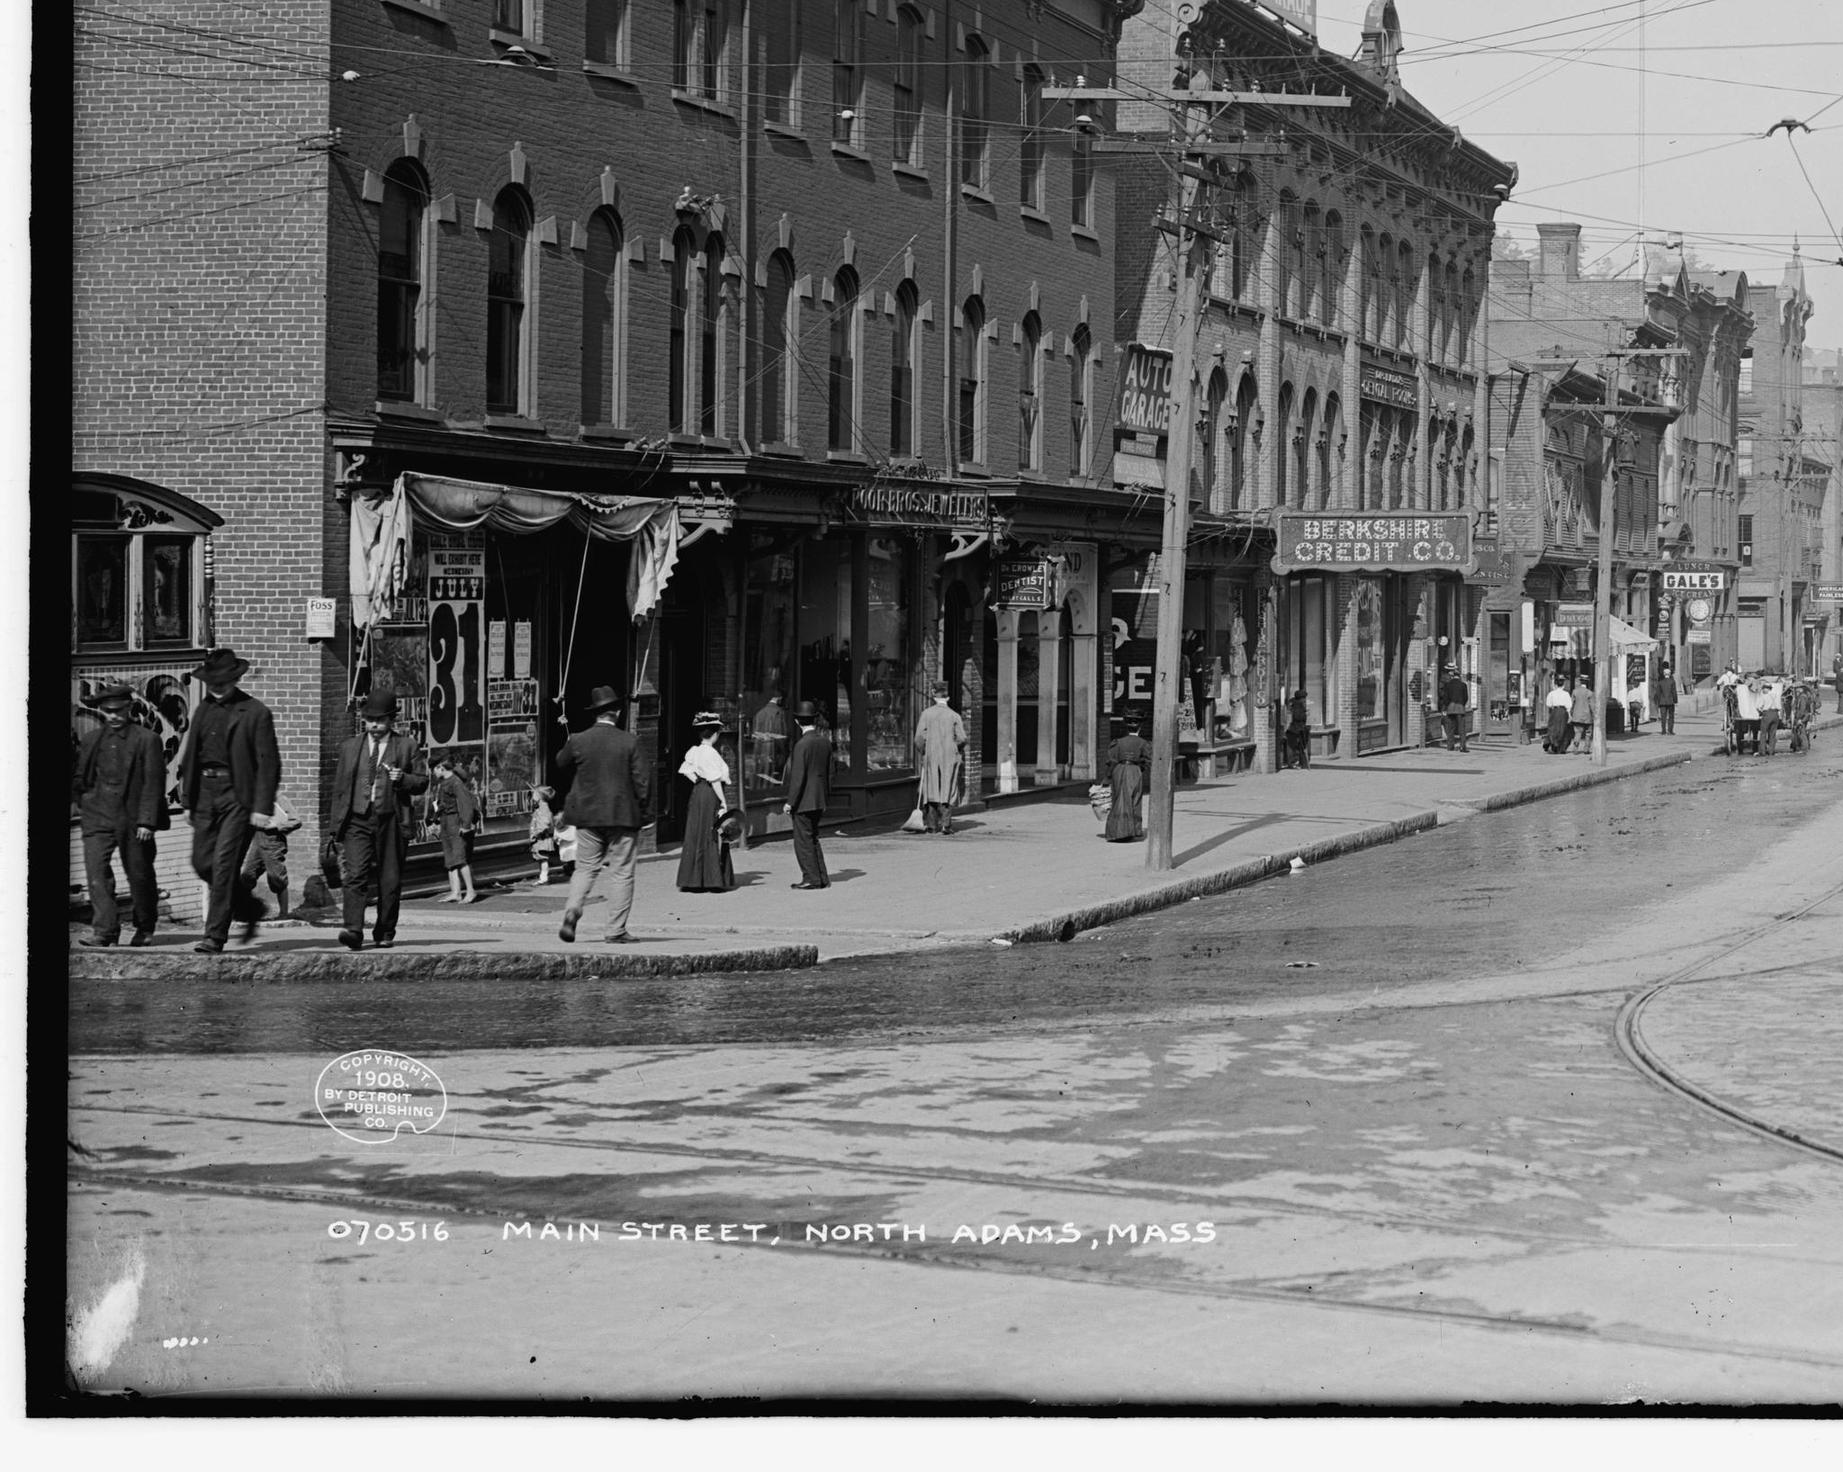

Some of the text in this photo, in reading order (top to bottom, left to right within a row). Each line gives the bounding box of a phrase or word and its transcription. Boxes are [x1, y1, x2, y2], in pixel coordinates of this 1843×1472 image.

[1125, 352, 1173, 393] AUTO
[1120, 390, 1170, 430] GARAGE
[1304, 520, 1447, 540] BERKSHIRE
[1295, 541, 1399, 561] CREDIT
[436, 579, 479, 598] JULY
[1001, 576, 1044, 592] DENTIST
[1666, 574, 1720, 588] GALE'S
[430, 602, 484, 744] 31
[522, 682, 538, 714] 31
